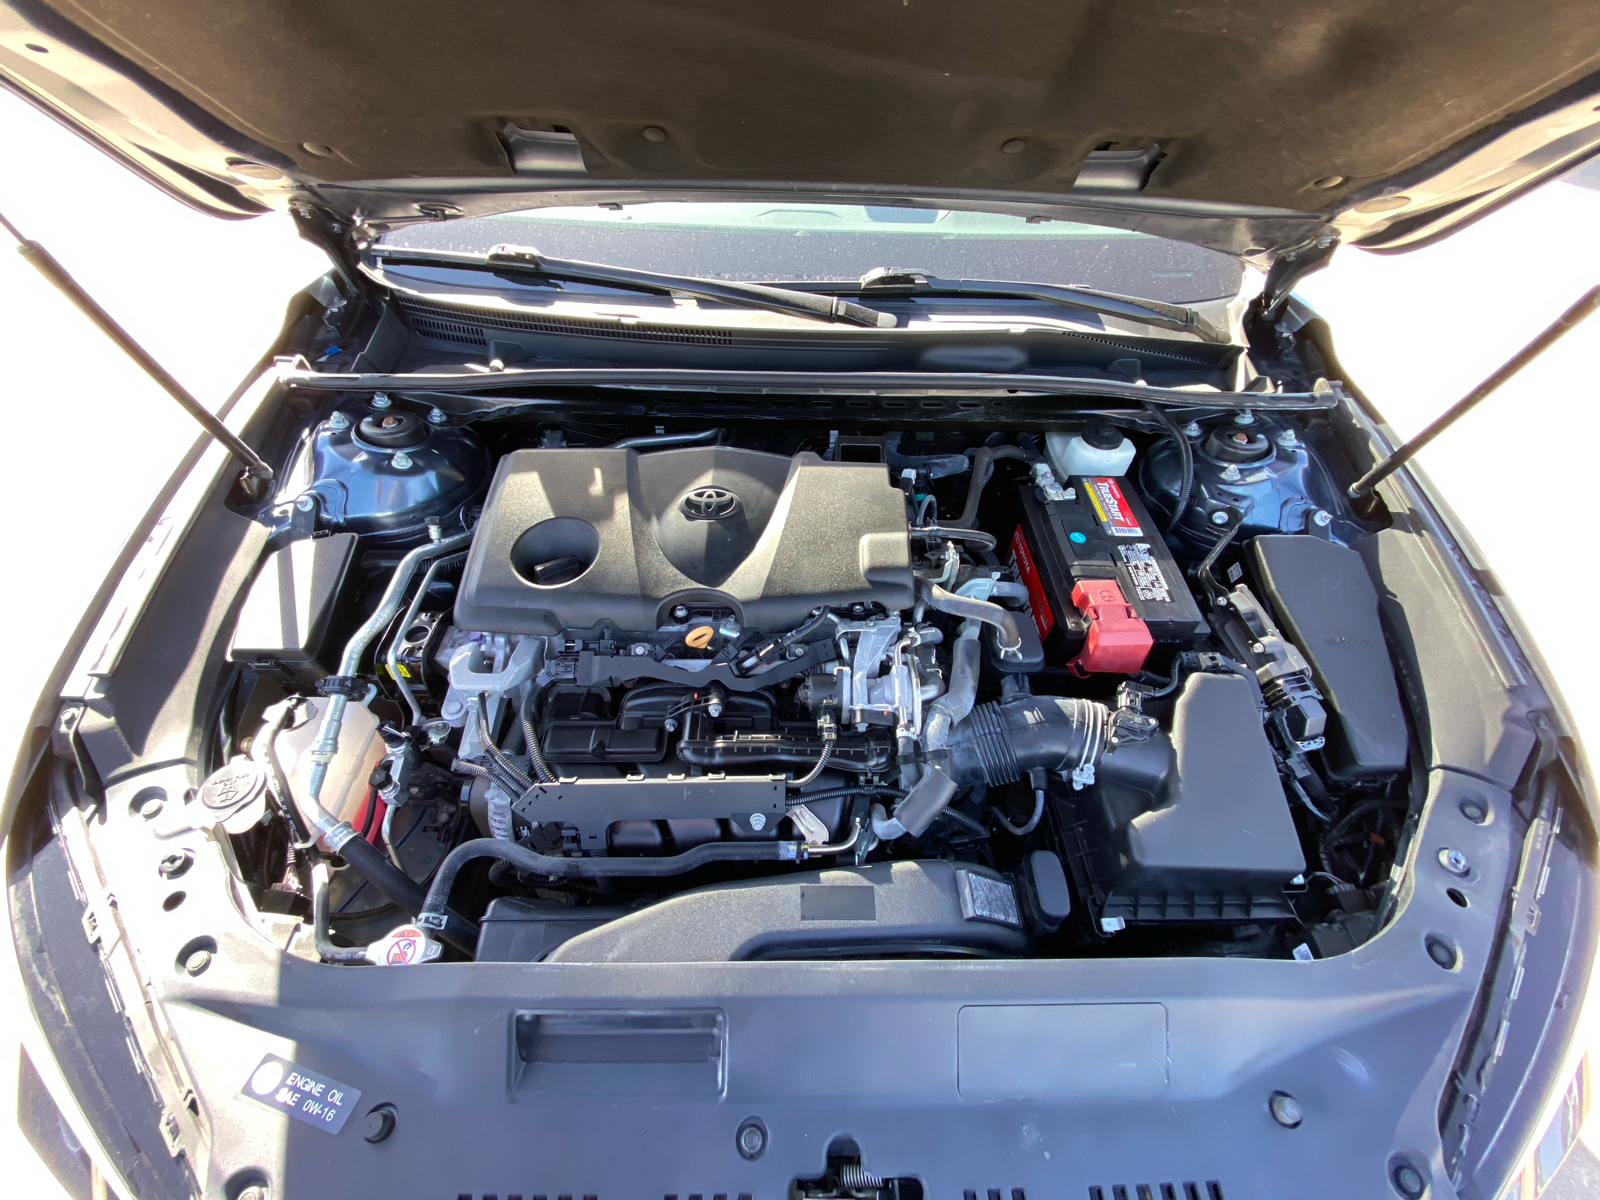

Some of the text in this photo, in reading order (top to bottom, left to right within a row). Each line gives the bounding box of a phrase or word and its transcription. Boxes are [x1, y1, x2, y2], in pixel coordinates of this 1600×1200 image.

[1019, 541, 1031, 575] TOYOTA
[285, 1072, 345, 1106] ENGINE OIL
[302, 1099, 336, 1122] 0W-16
